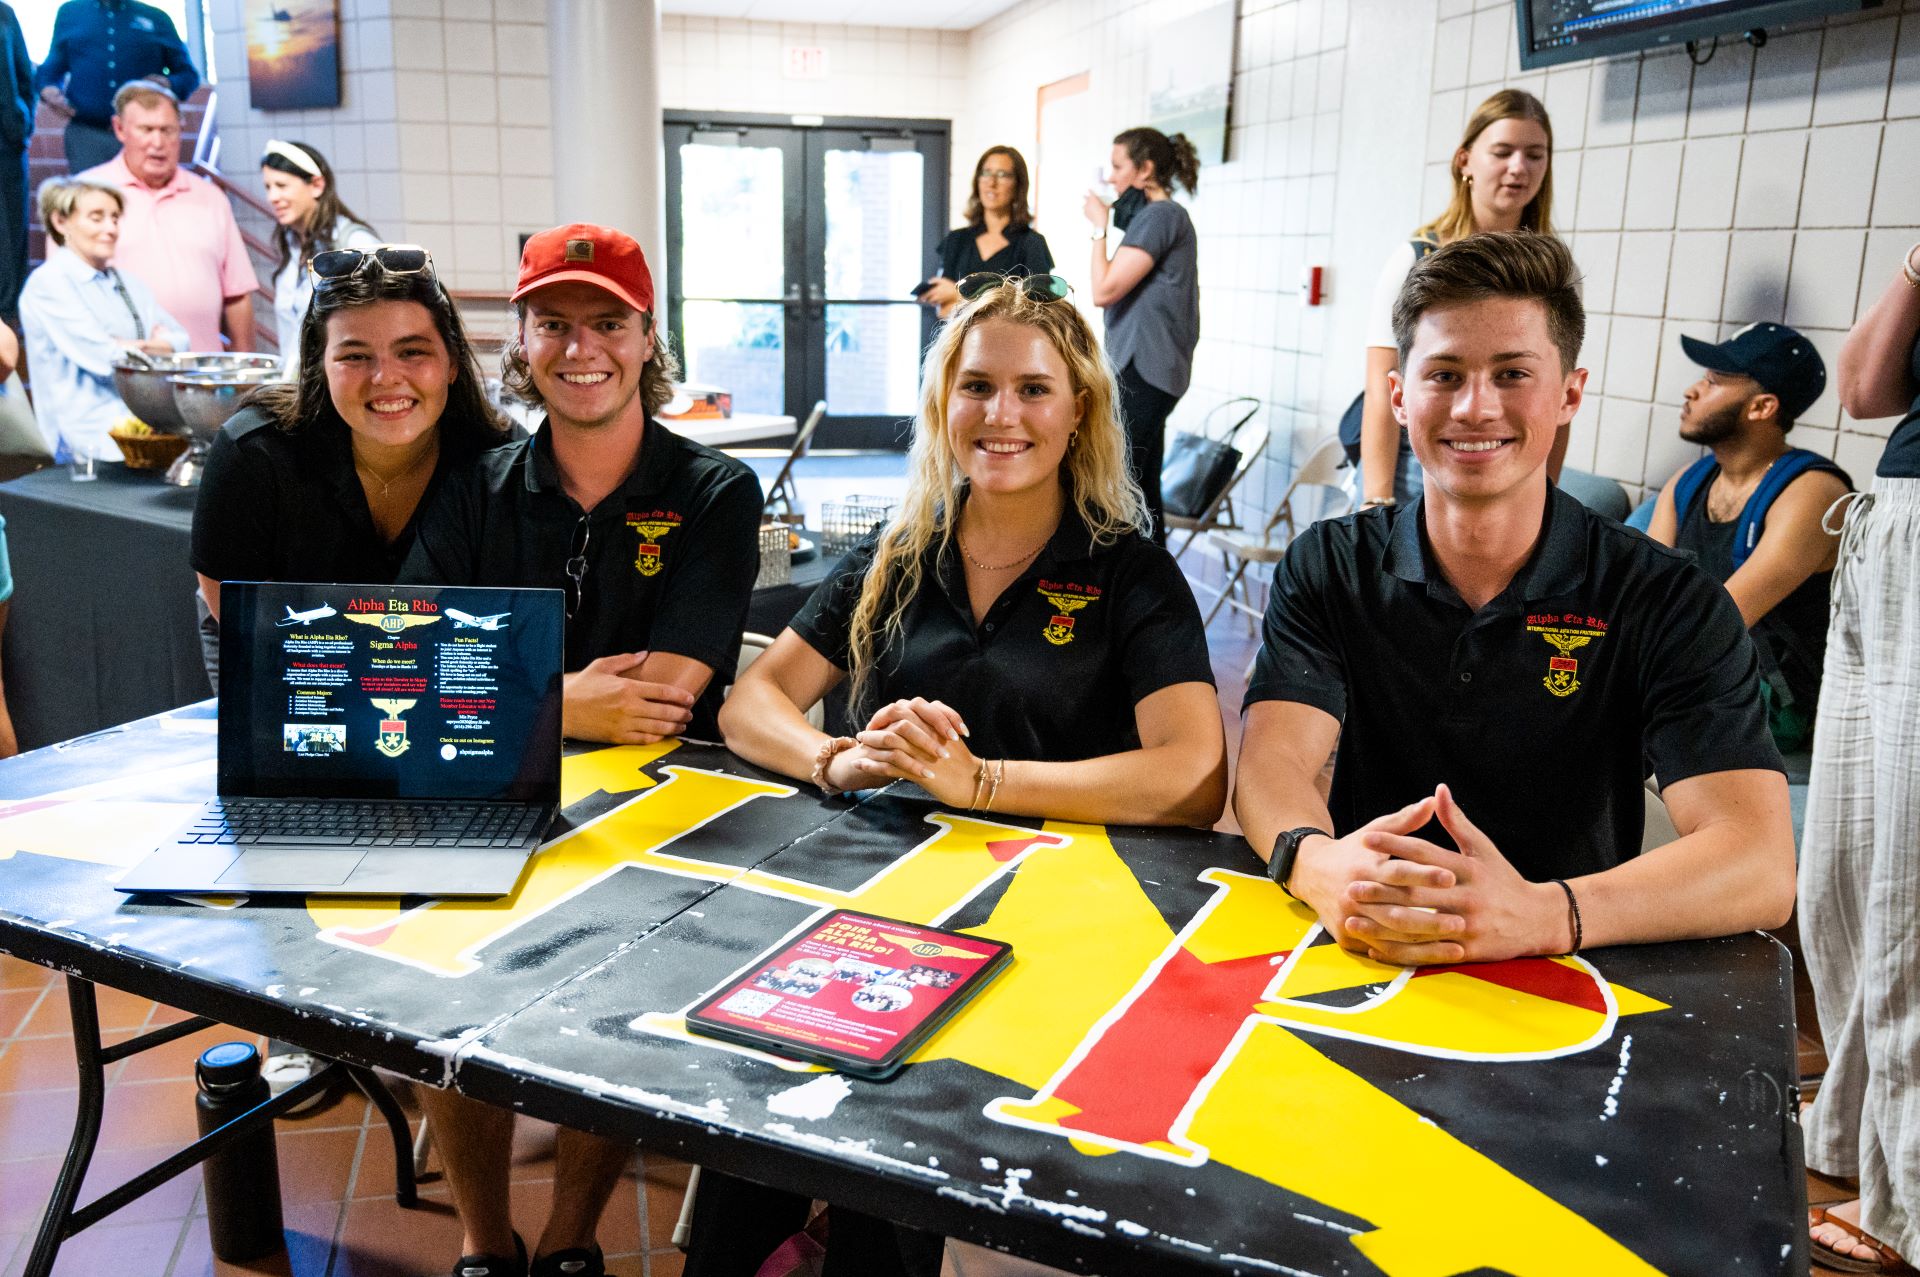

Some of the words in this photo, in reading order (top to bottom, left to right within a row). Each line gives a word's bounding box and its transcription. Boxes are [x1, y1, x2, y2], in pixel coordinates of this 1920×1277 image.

[348, 599, 385, 613] Alpha
[388, 600, 409, 611] Eta
[413, 600, 438, 612] Rho
[383, 619, 404, 629] AHP
[1527, 614, 1558, 624] Alpha
[1564, 614, 1584, 624] Eta
[1586, 616, 1608, 630] Rho
[370, 641, 393, 650] Sigma
[395, 641, 417, 650] Alpha
[828, 922, 872, 935] JOIN
[821, 927, 878, 944] ALPHA
[813, 933, 846, 945] ETA
[848, 940, 895, 955] RHO!
[912, 944, 942, 955] AHP
